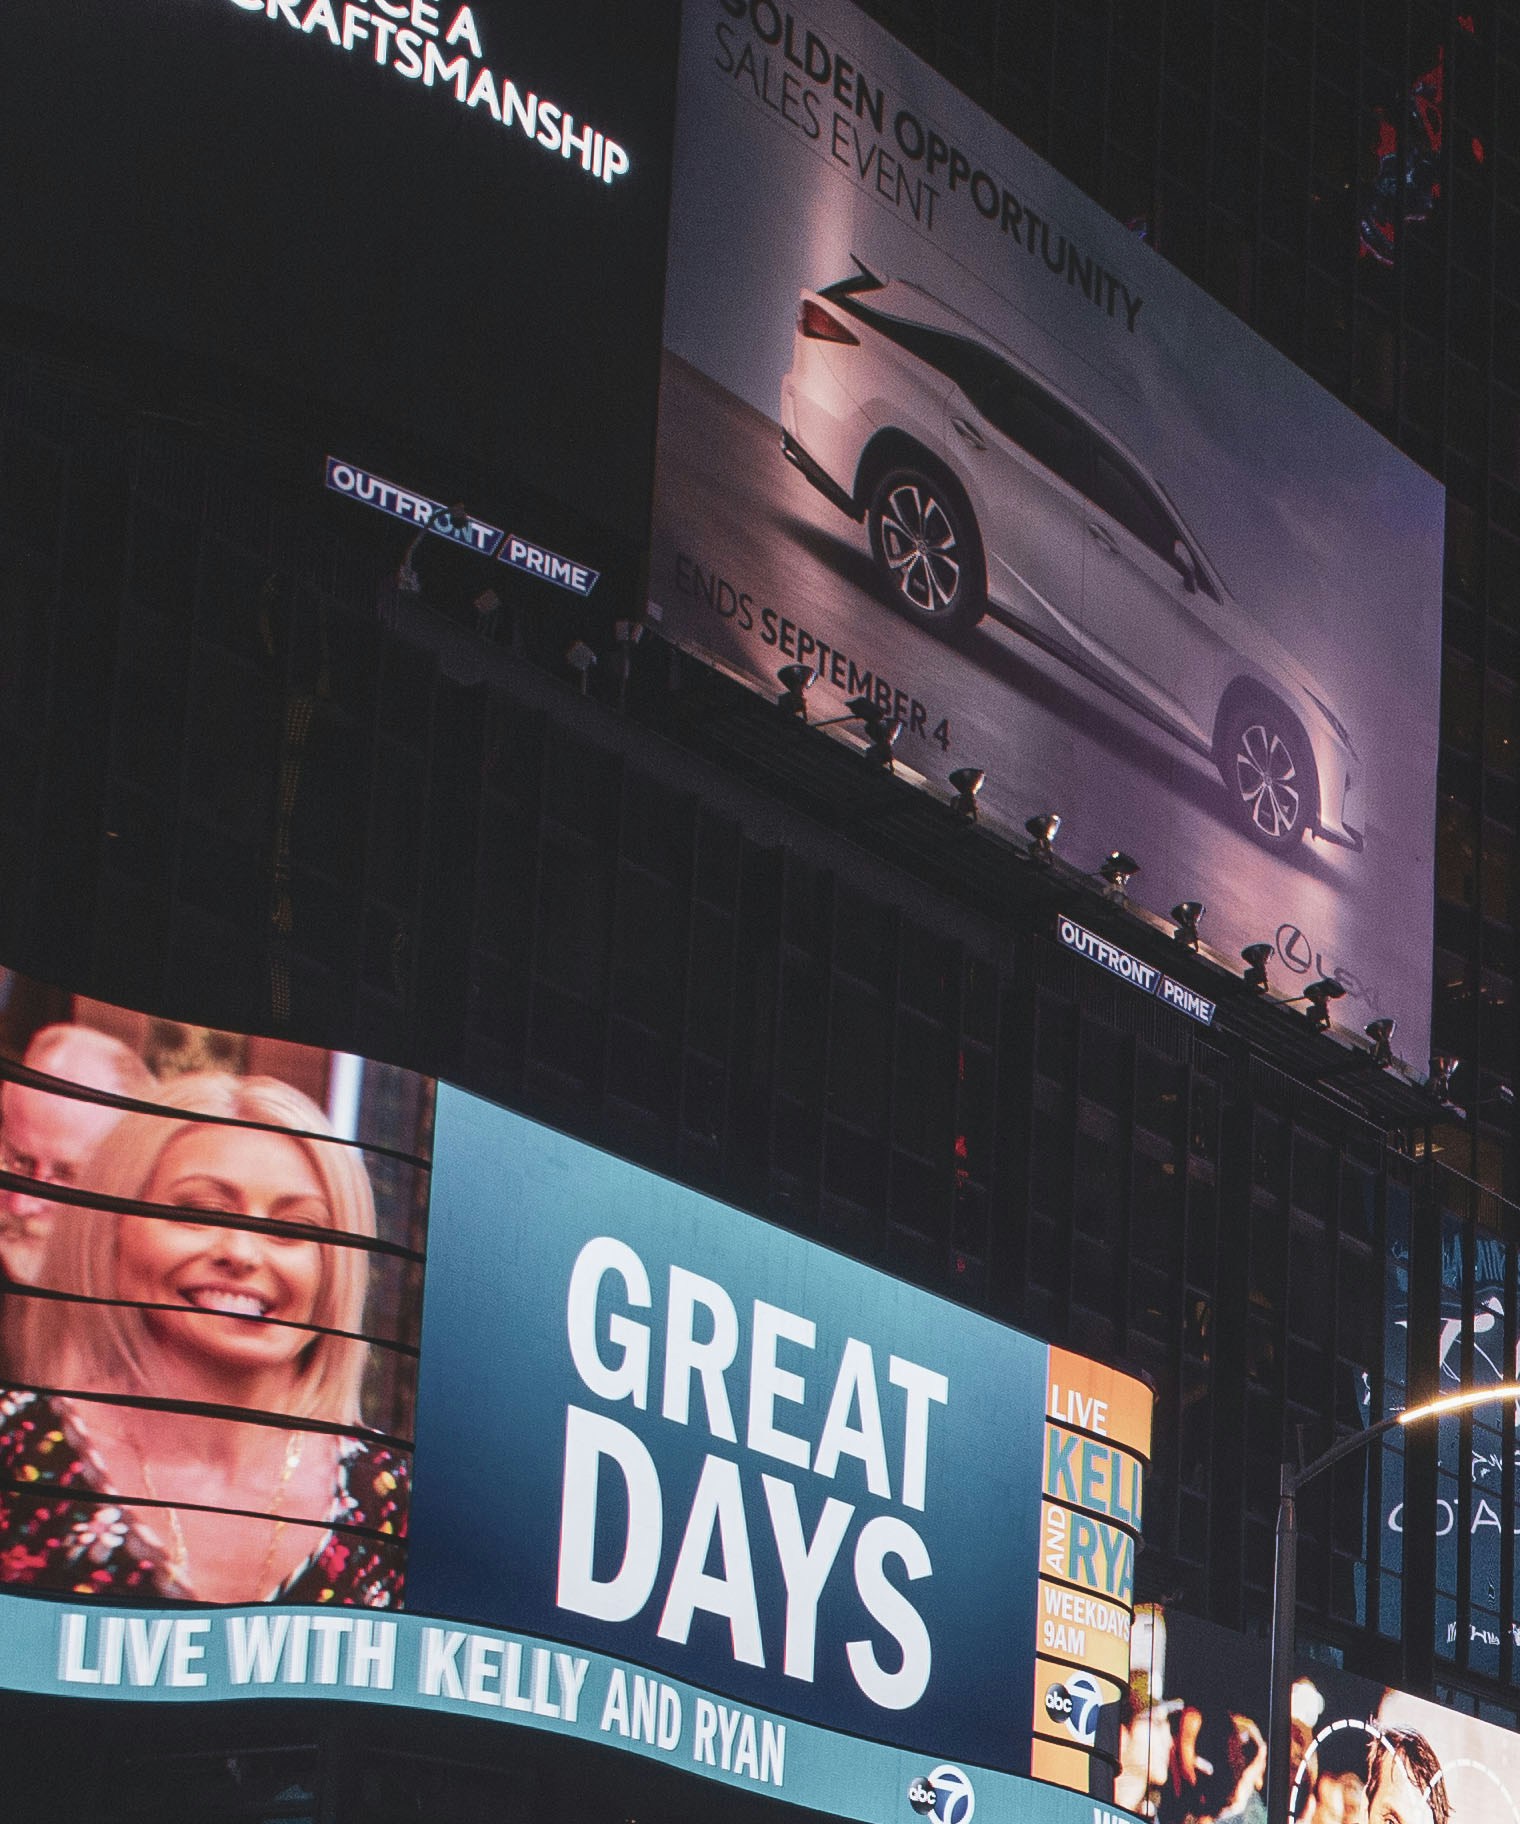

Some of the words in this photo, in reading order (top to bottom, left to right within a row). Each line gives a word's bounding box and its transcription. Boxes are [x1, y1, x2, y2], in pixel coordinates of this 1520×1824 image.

[446, 5, 482, 58] A
[714, 21, 821, 140] SALES
[831, 111, 941, 231] EVENT
[893, 111, 1144, 333] OPPORTUNITY
[510, 539, 588, 592] PRIME
[675, 553, 753, 631] ENDS
[760, 606, 928, 741] SEPTEMBER
[933, 718, 951, 751] 4
[1061, 919, 1156, 990] OUTFRONT
[1163, 978, 1211, 1022] PRIME
[567, 1236, 950, 1513] GREAT
[1051, 1384, 1109, 1438] LIVE
[556, 1403, 934, 1711] DAYS
[1045, 1506, 1067, 1575] AND
[1043, 1624, 1086, 1657] 9AM
[1044, 1585, 1131, 1639] WEEKDAYS
[57, 1613, 212, 1688] LIVE
[225, 1614, 399, 1691] WITH
[417, 1626, 591, 1723] KELLY
[600, 1669, 683, 1752] AND
[693, 1697, 788, 1788] RYAN
[908, 1783, 937, 1806] abc
[1045, 1682, 1073, 1714] abc
